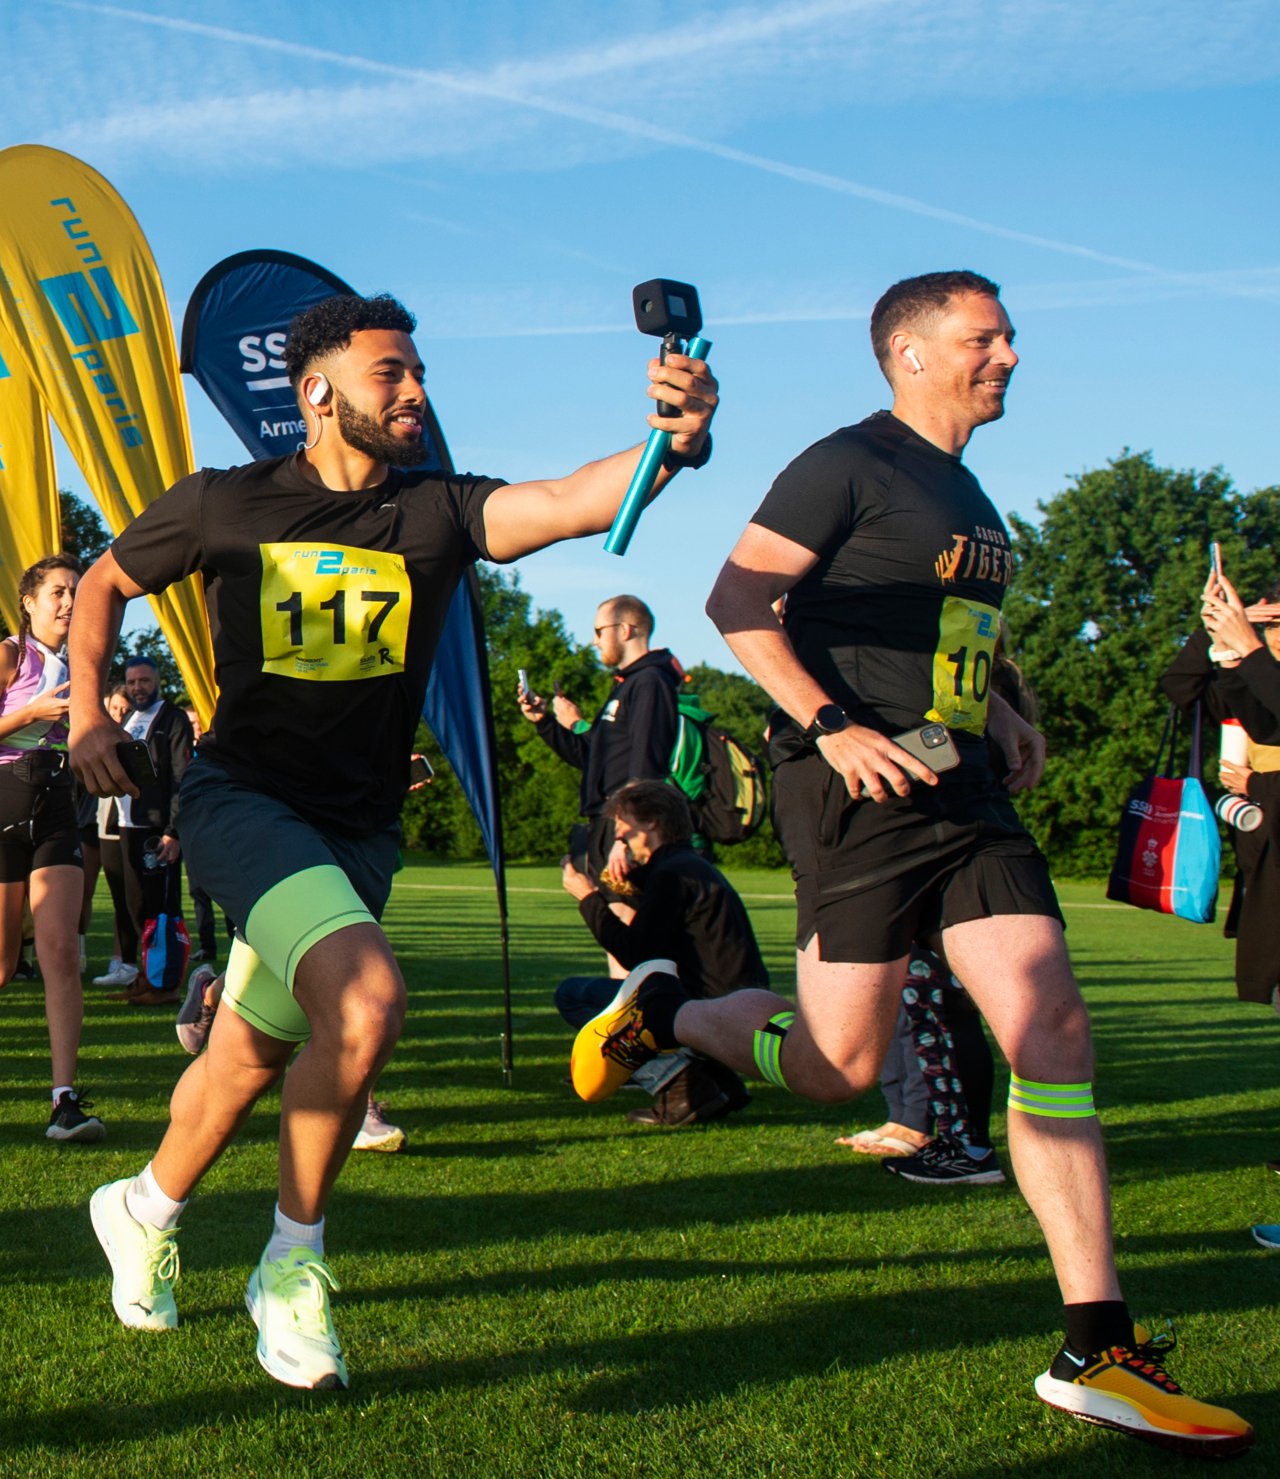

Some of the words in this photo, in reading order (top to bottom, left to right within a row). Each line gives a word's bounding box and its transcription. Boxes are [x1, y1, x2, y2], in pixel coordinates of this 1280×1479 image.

[50, 197, 103, 264] run
[72, 351, 145, 449] paris
[260, 420, 308, 439] Arme
[276, 589, 400, 646] 117
[946, 645, 992, 703] 10
